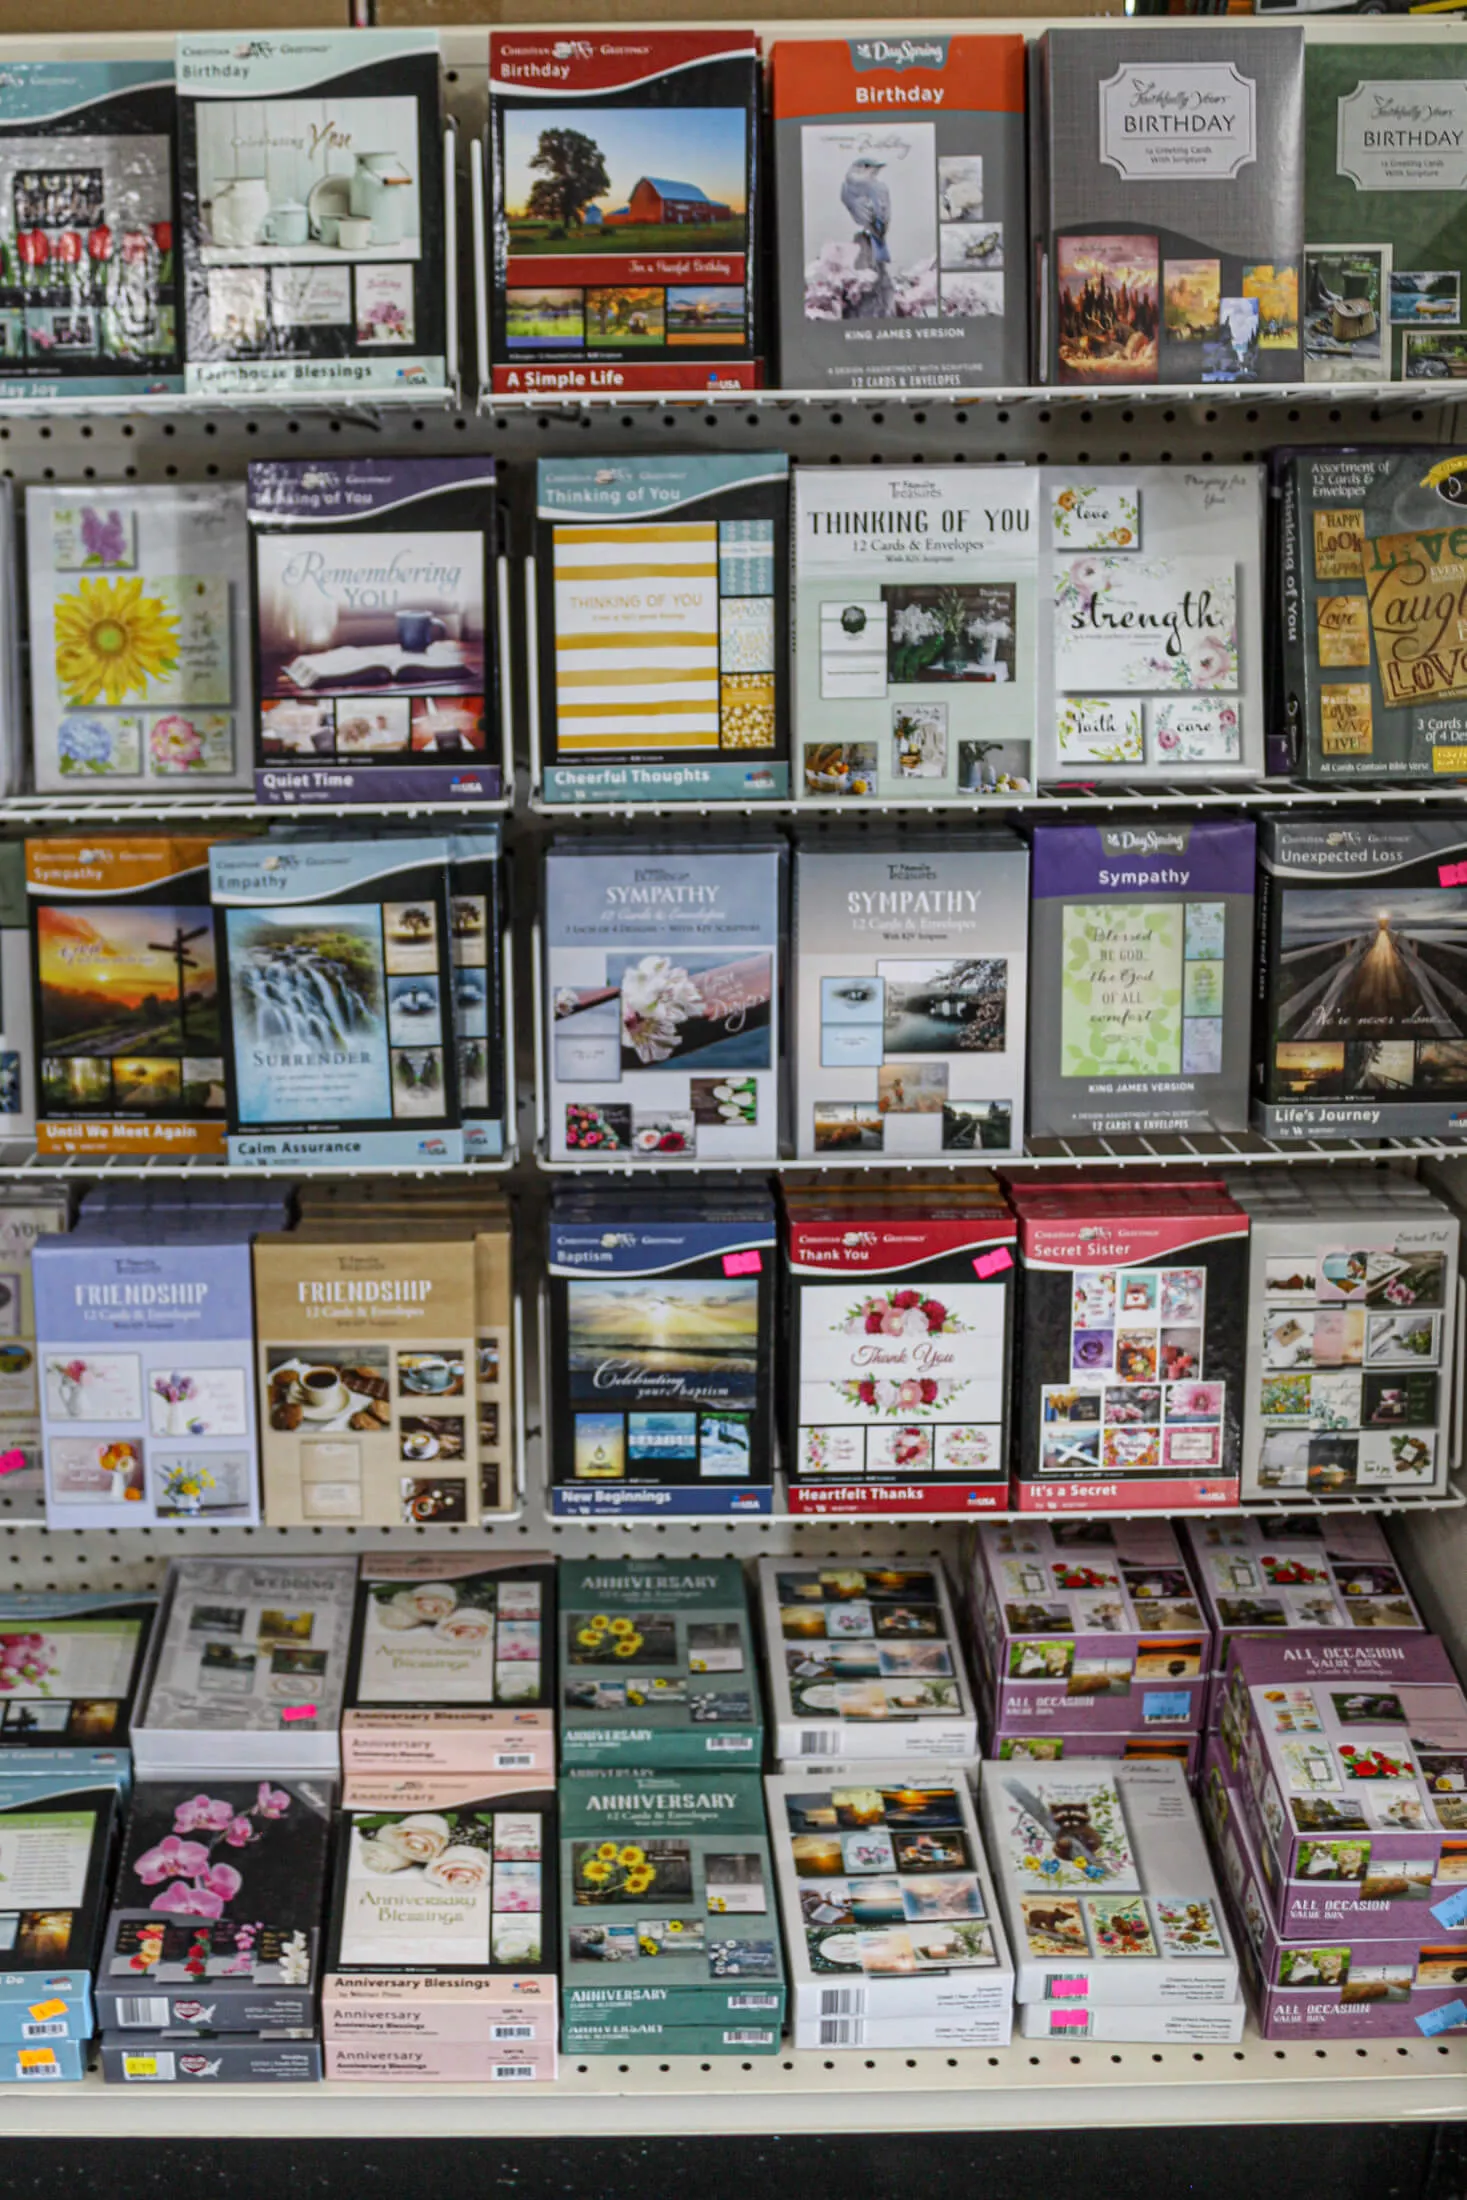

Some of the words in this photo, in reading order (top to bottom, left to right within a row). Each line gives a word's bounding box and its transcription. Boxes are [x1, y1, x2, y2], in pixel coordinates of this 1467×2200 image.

[872, 41, 943, 63] DaySpring
[182, 62, 249, 80] Birthday
[501, 63, 570, 79] Birthday
[856, 86, 944, 104] Birthday
[1124, 115, 1236, 133] BIRTHDAY
[1364, 131, 1464, 146] BIRTHDAY
[845, 330, 873, 340] KING
[876, 329, 912, 340] JAMES
[916, 328, 964, 338] VERSION
[295, 364, 372, 379] Blessings
[507, 372, 520, 386] A
[524, 371, 585, 389] Simple
[590, 371, 624, 385] Life
[1311, 462, 1375, 474] Assortment
[1379, 461, 1390, 474] of
[1313, 475, 1325, 484] 12
[1328, 474, 1360, 484] Cards
[345, 492, 373, 504] You
[546, 489, 621, 505] Thinking
[626, 487, 644, 501] of
[650, 487, 680, 500] You
[1312, 486, 1366, 499] Envelopes
[807, 510, 928, 535] THINKING
[942, 509, 970, 533] OF
[984, 509, 1030, 532] YOU
[1327, 512, 1361, 528] HAPPY
[853, 541, 867, 551] 12
[871, 539, 904, 551] Cards
[908, 540, 920, 550] &
[926, 538, 984, 552] Envelopes
[281, 550, 461, 599] Remembering
[1286, 576, 1298, 597] of
[344, 588, 398, 608] YOU
[570, 596, 641, 609] THINKING
[646, 594, 665, 607] OF
[672, 593, 702, 607] YOU
[1071, 590, 1220, 656] strength
[1288, 601, 1298, 640] You
[1176, 722, 1212, 733] care
[1418, 720, 1424, 729] 3
[1427, 718, 1461, 729] Cards
[1425, 732, 1437, 744] of
[1440, 731, 1447, 741] 4
[263, 774, 309, 788] Quiet
[314, 773, 354, 786] Time
[555, 770, 627, 785] Cheerful
[632, 768, 710, 784] Thoughts
[1122, 831, 1183, 851] DaySpring
[1282, 851, 1367, 864] Unexpected
[1372, 850, 1403, 861] Loss
[34, 867, 103, 881] Sympathy
[1099, 869, 1190, 886] Sympathy
[218, 876, 287, 890] Empathy
[606, 885, 721, 904] SYMPATHY
[848, 890, 982, 914] SYMPATHY
[1122, 992, 1143, 1004] ALL
[1358, 1016, 1394, 1024] never
[253, 1051, 371, 1067] SURRENDER
[1088, 1084, 1113, 1093] KING
[1116, 1083, 1148, 1092] JAMES
[1152, 1082, 1194, 1091] VERSION
[1275, 1109, 1314, 1122] Life's
[1320, 1109, 1380, 1123] Journey
[46, 1125, 84, 1138] Until
[86, 1126, 108, 1137] We
[112, 1124, 149, 1137] Meet
[153, 1125, 197, 1141] Again
[1092, 1121, 1101, 1130] 12
[238, 1143, 276, 1155] Calm
[282, 1141, 361, 1154] Assurance
[799, 1250, 840, 1260] Thank
[845, 1249, 869, 1260] You
[1034, 1244, 1082, 1257] Secret
[1087, 1243, 1130, 1256] Sister
[557, 1251, 613, 1264] Baptism
[75, 1282, 208, 1306] FRIENDSHIP
[297, 1280, 433, 1303] FRIENDSHIP
[850, 1345, 907, 1366] Thank
[913, 1342, 955, 1372] You
[593, 1359, 685, 1391] Celebrating
[680, 1385, 728, 1398] baptism
[799, 1489, 866, 1501] Heartfelt
[871, 1488, 923, 1499] Thanks
[1030, 1485, 1052, 1496] It's
[1057, 1487, 1065, 1496] a
[1070, 1484, 1117, 1496] Secret
[562, 1492, 592, 1503] New
[595, 1491, 670, 1504] Beginnings
[582, 1576, 719, 1589] ANNIVERSARY
[1284, 1649, 1312, 1661] ALL
[1323, 1647, 1404, 1660] OCCASION
[586, 1794, 737, 1810] ANNIVERSARY
[1291, 1900, 1318, 1910] ALL
[1324, 1901, 1391, 1911] OCCASION
[334, 1978, 420, 1989] Anniversary
[424, 1978, 490, 1990] Blessings
[572, 1989, 668, 2001] ANNIVERSARY
[334, 2010, 421, 2020] Anniversary
[1275, 2004, 1300, 2014] ALL
[1307, 2004, 1371, 2014] OCCASION
[336, 2052, 422, 2061] Anniversary
